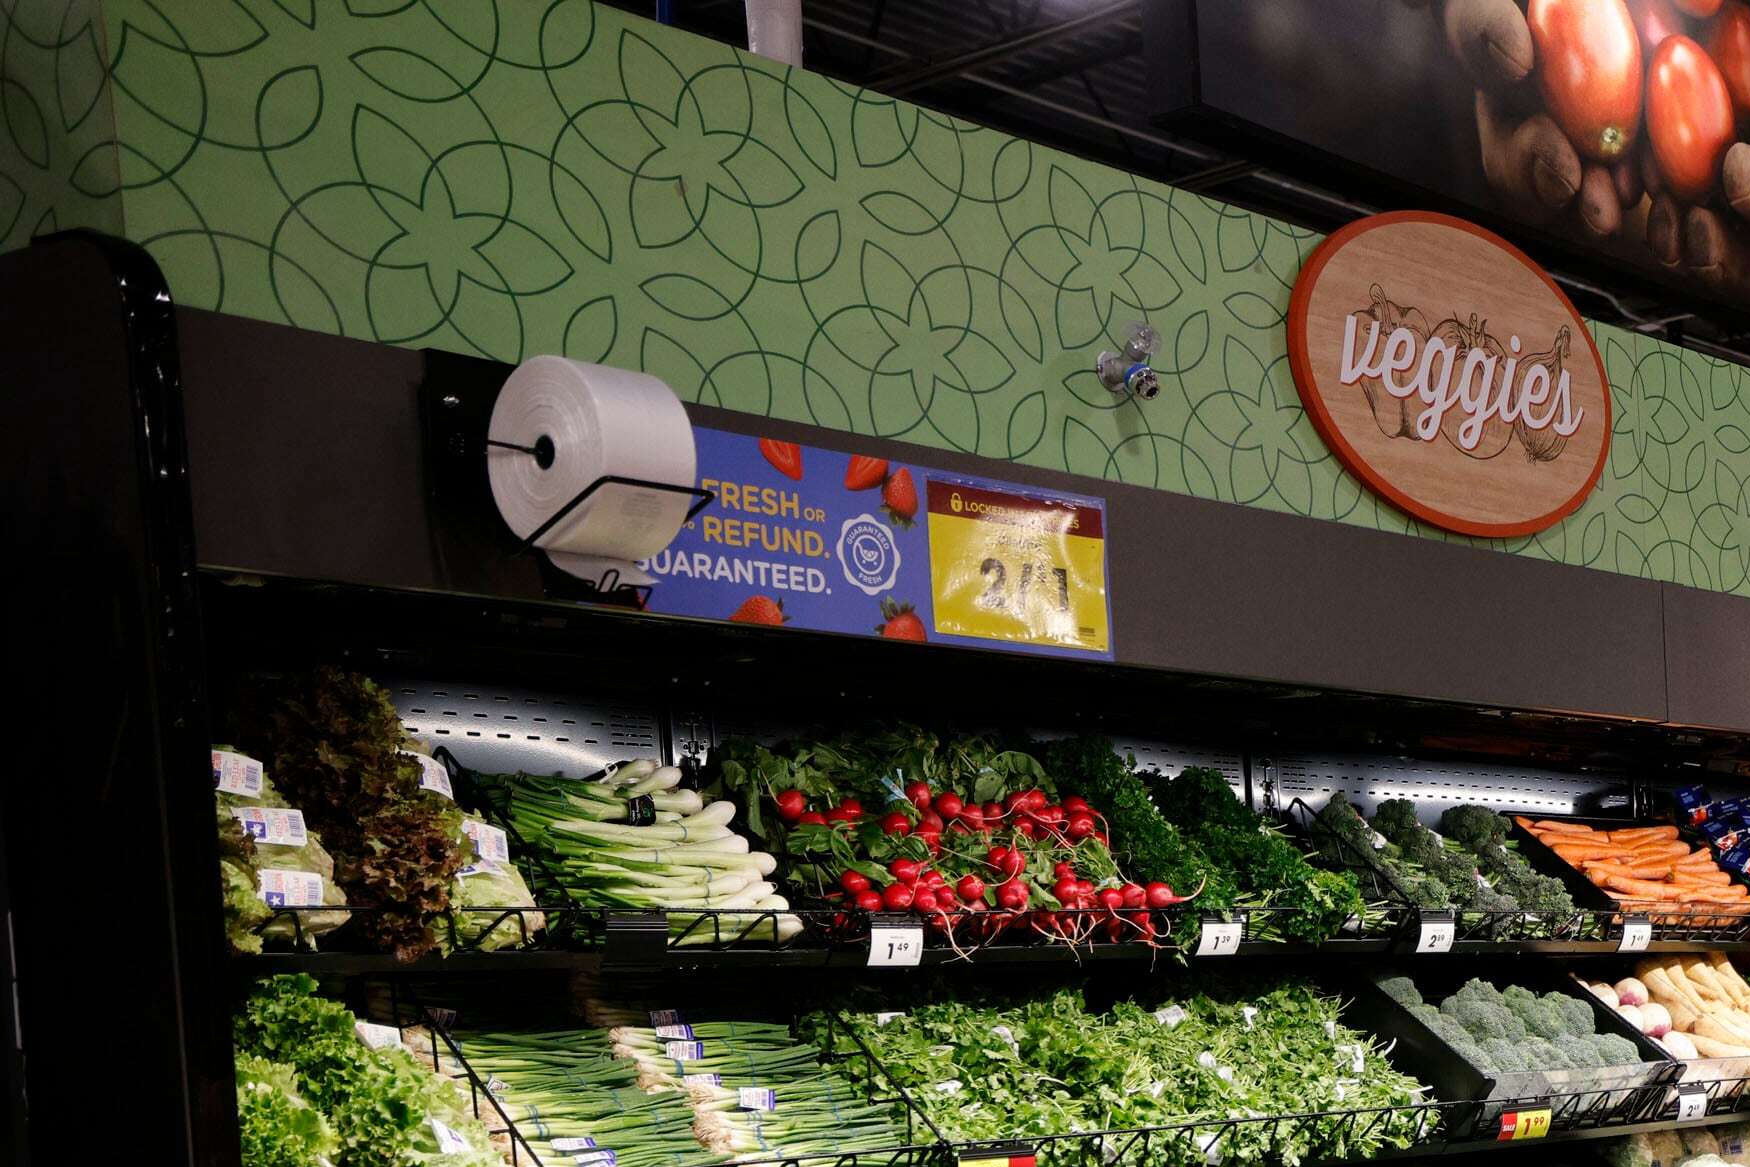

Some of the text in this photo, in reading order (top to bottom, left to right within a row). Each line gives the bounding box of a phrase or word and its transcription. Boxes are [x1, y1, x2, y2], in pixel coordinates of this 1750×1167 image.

[1340, 314, 1584, 450] veggies
[702, 478, 826, 522] FRESH OR
[703, 515, 831, 560] REFUND.
[846, 525, 890, 550] GUARANTEED
[858, 572, 882, 585] FRESH
